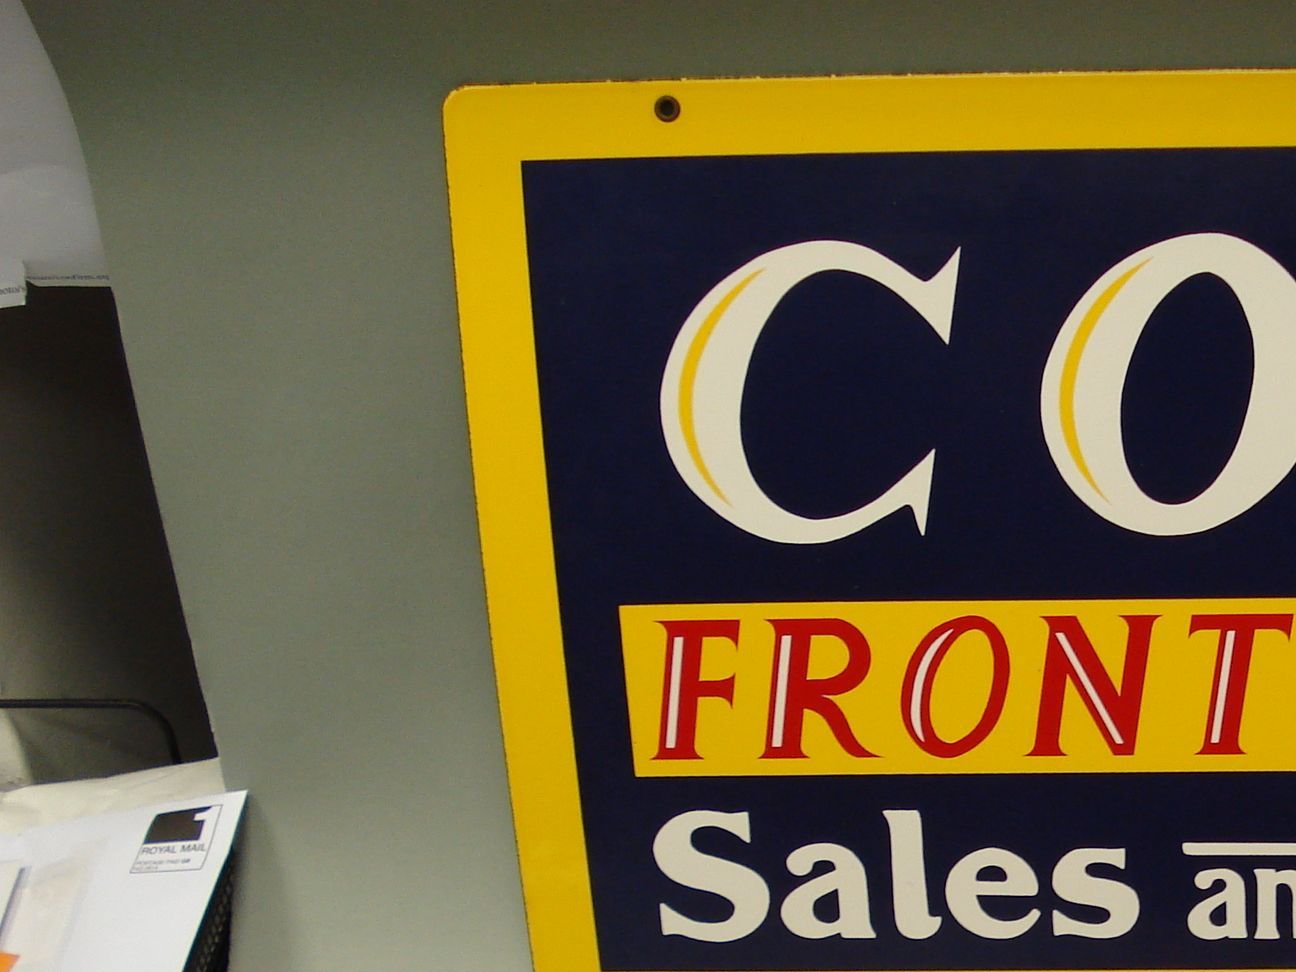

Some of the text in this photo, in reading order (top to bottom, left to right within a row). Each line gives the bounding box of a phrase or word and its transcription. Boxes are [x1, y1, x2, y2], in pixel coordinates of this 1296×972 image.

[650, 614, 1294, 760] FRONT
[140, 843, 206, 856] ROYAL MAIL
[652, 809, 1141, 943] Sales
